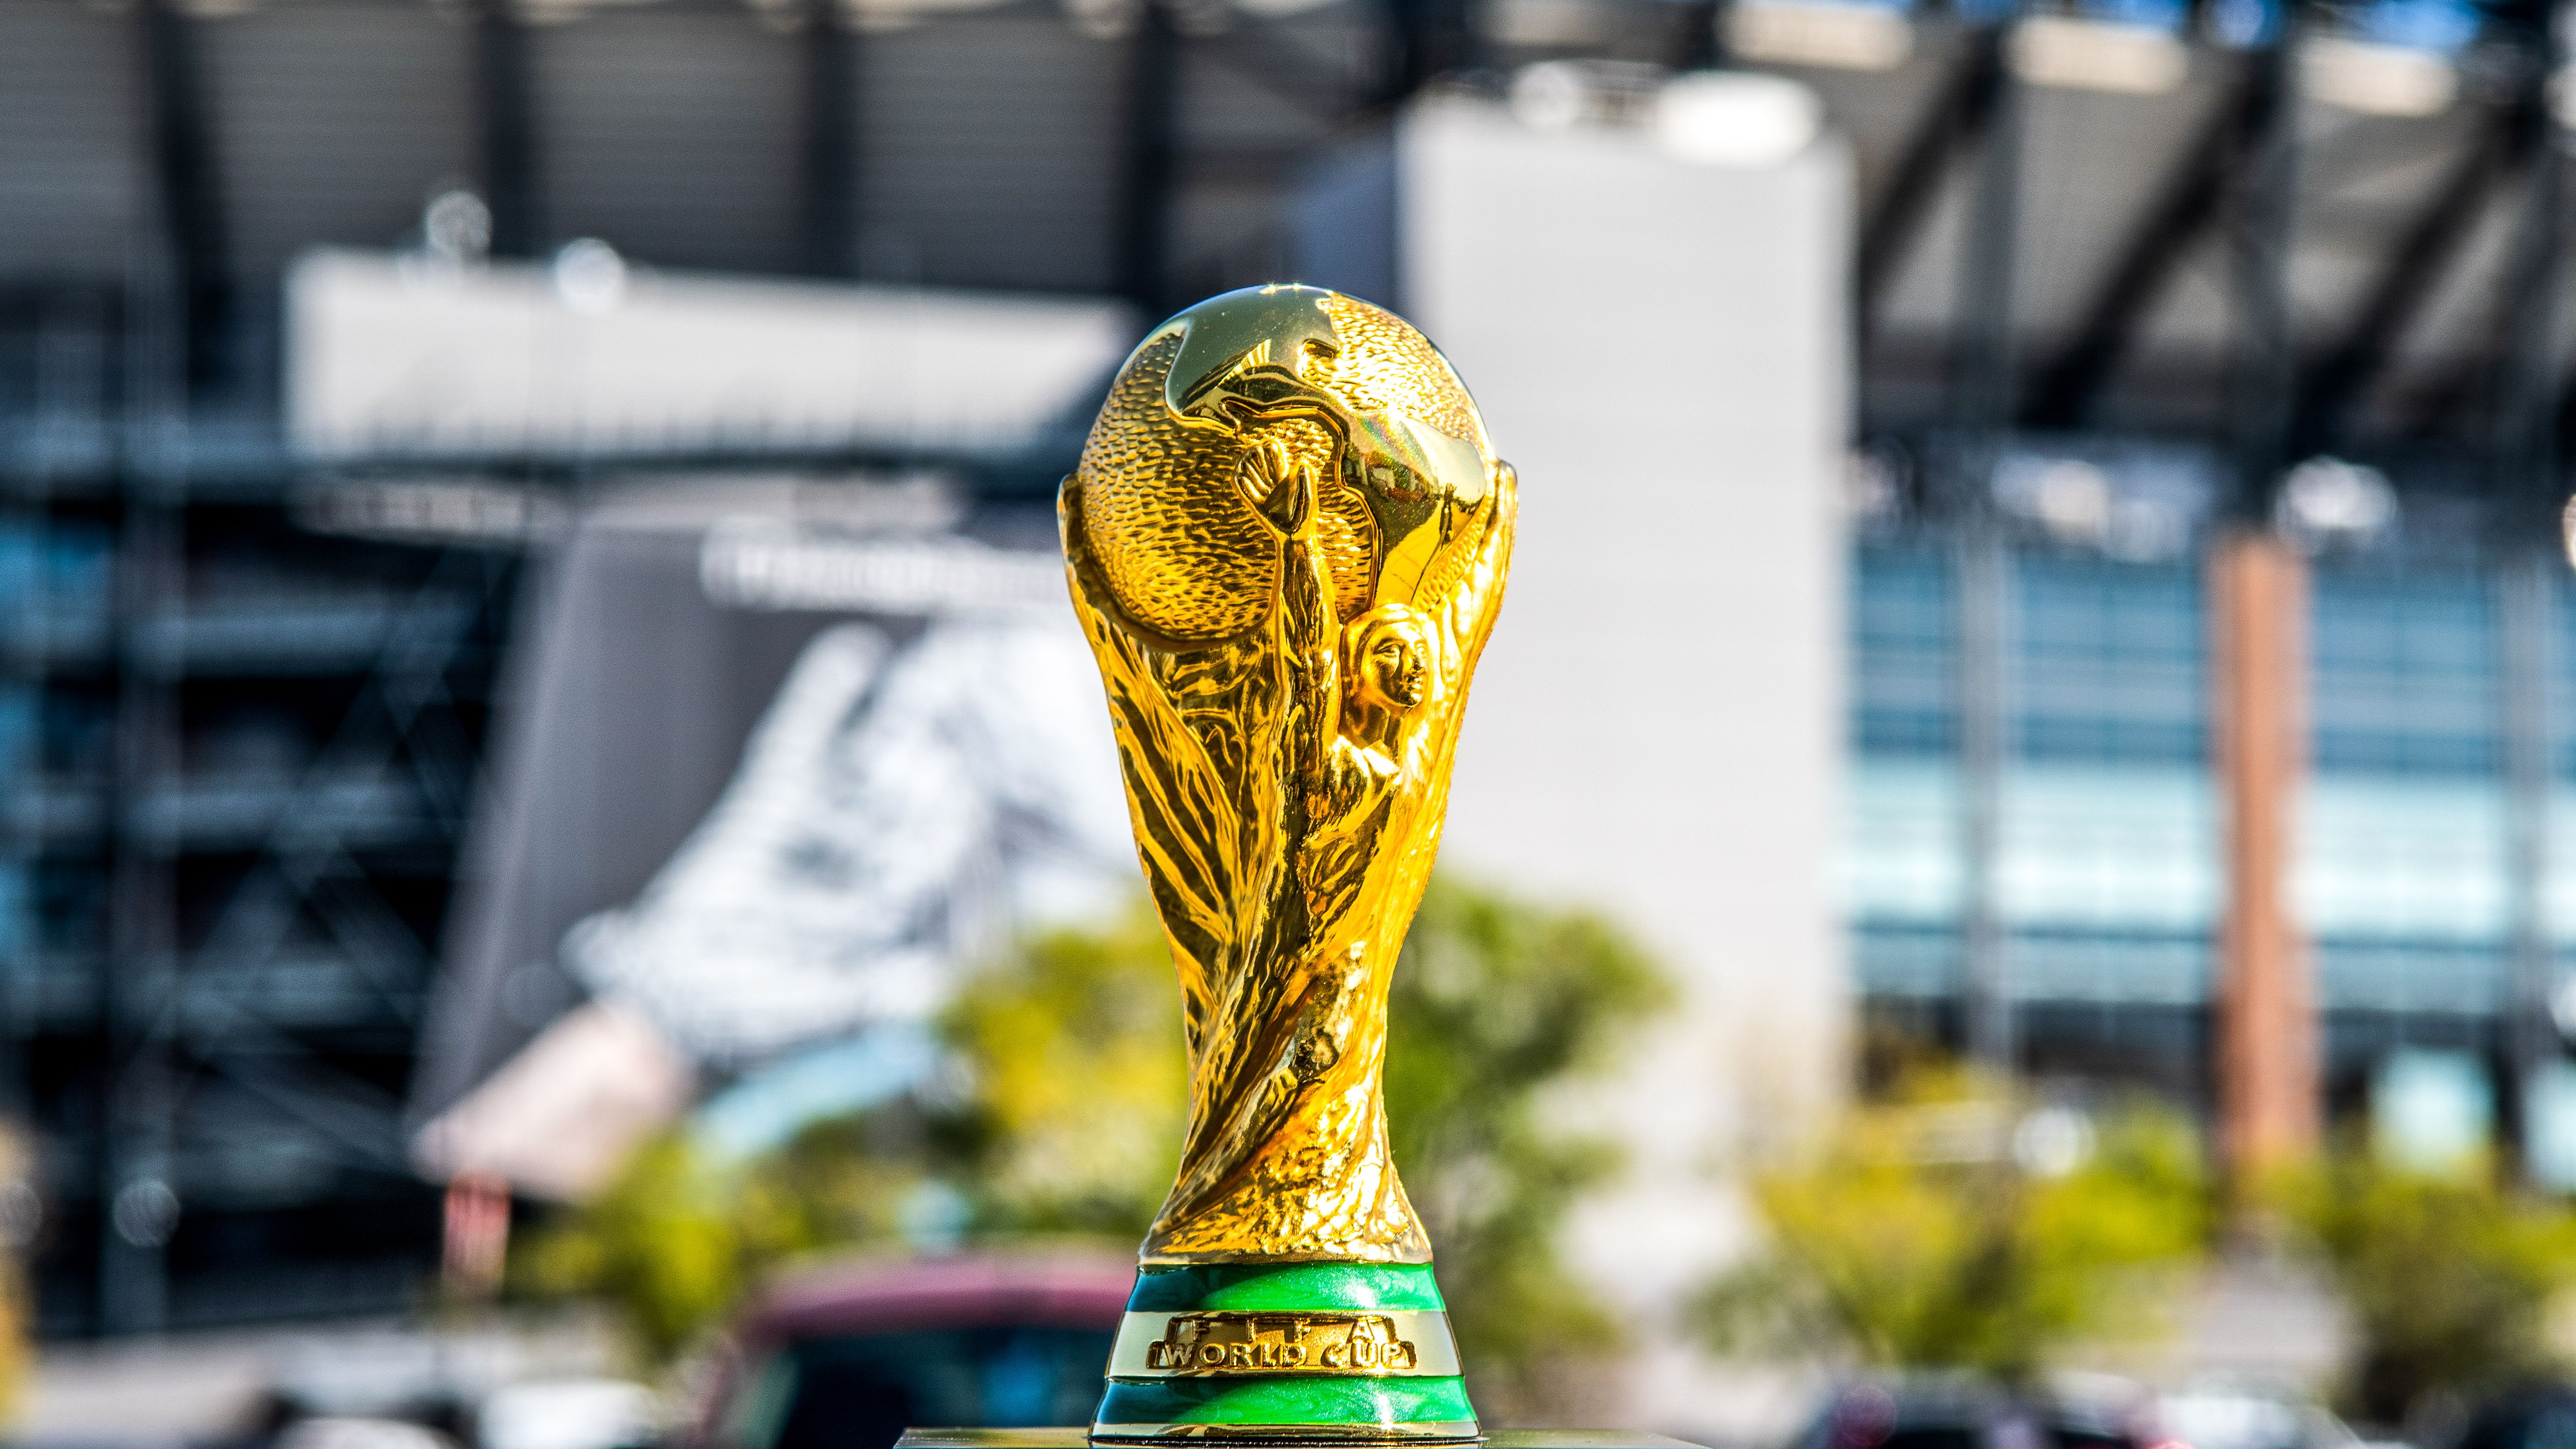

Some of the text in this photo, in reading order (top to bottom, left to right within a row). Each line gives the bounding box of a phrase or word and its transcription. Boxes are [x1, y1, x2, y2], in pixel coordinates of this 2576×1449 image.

[1191, 1317, 1375, 1343] FIFA
[1165, 1341, 1402, 1367] WORLD CUP
